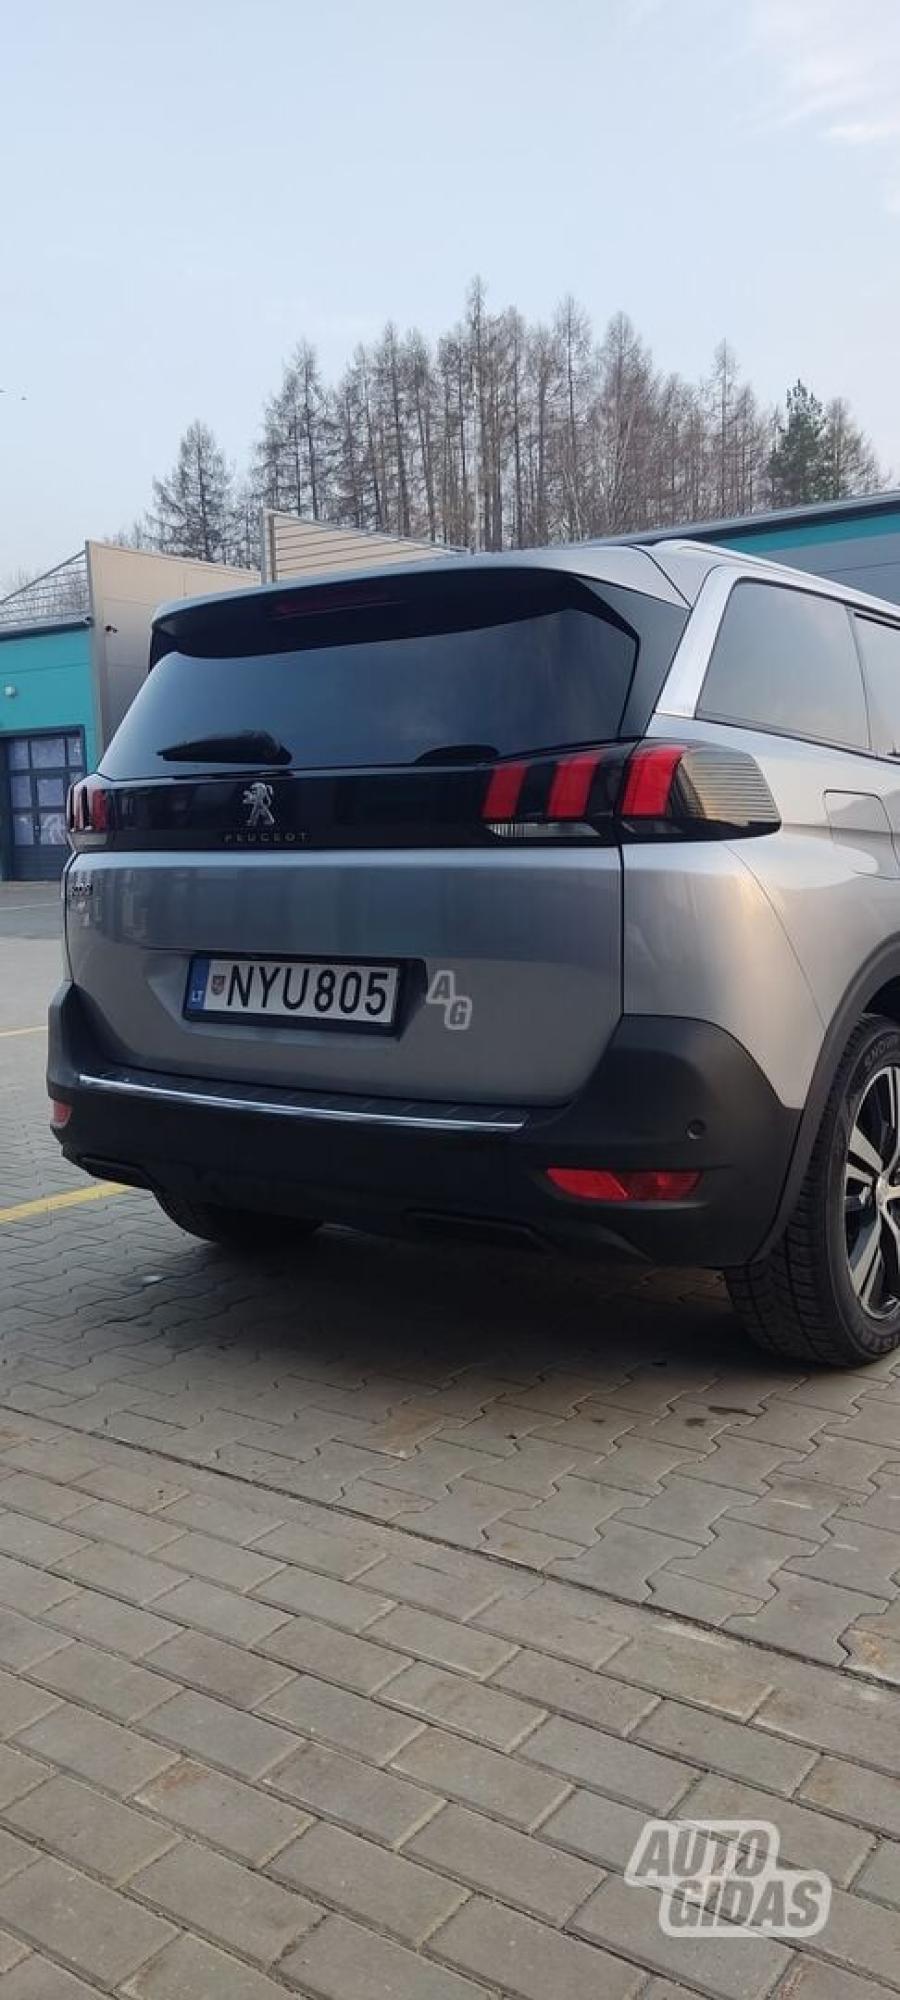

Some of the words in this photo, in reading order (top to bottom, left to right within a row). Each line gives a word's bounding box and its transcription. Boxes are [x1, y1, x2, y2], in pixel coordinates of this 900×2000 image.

[224, 832, 309, 842] PEUGEOT
[192, 990, 204, 1003] LT
[227, 965, 389, 1016] NYU805
